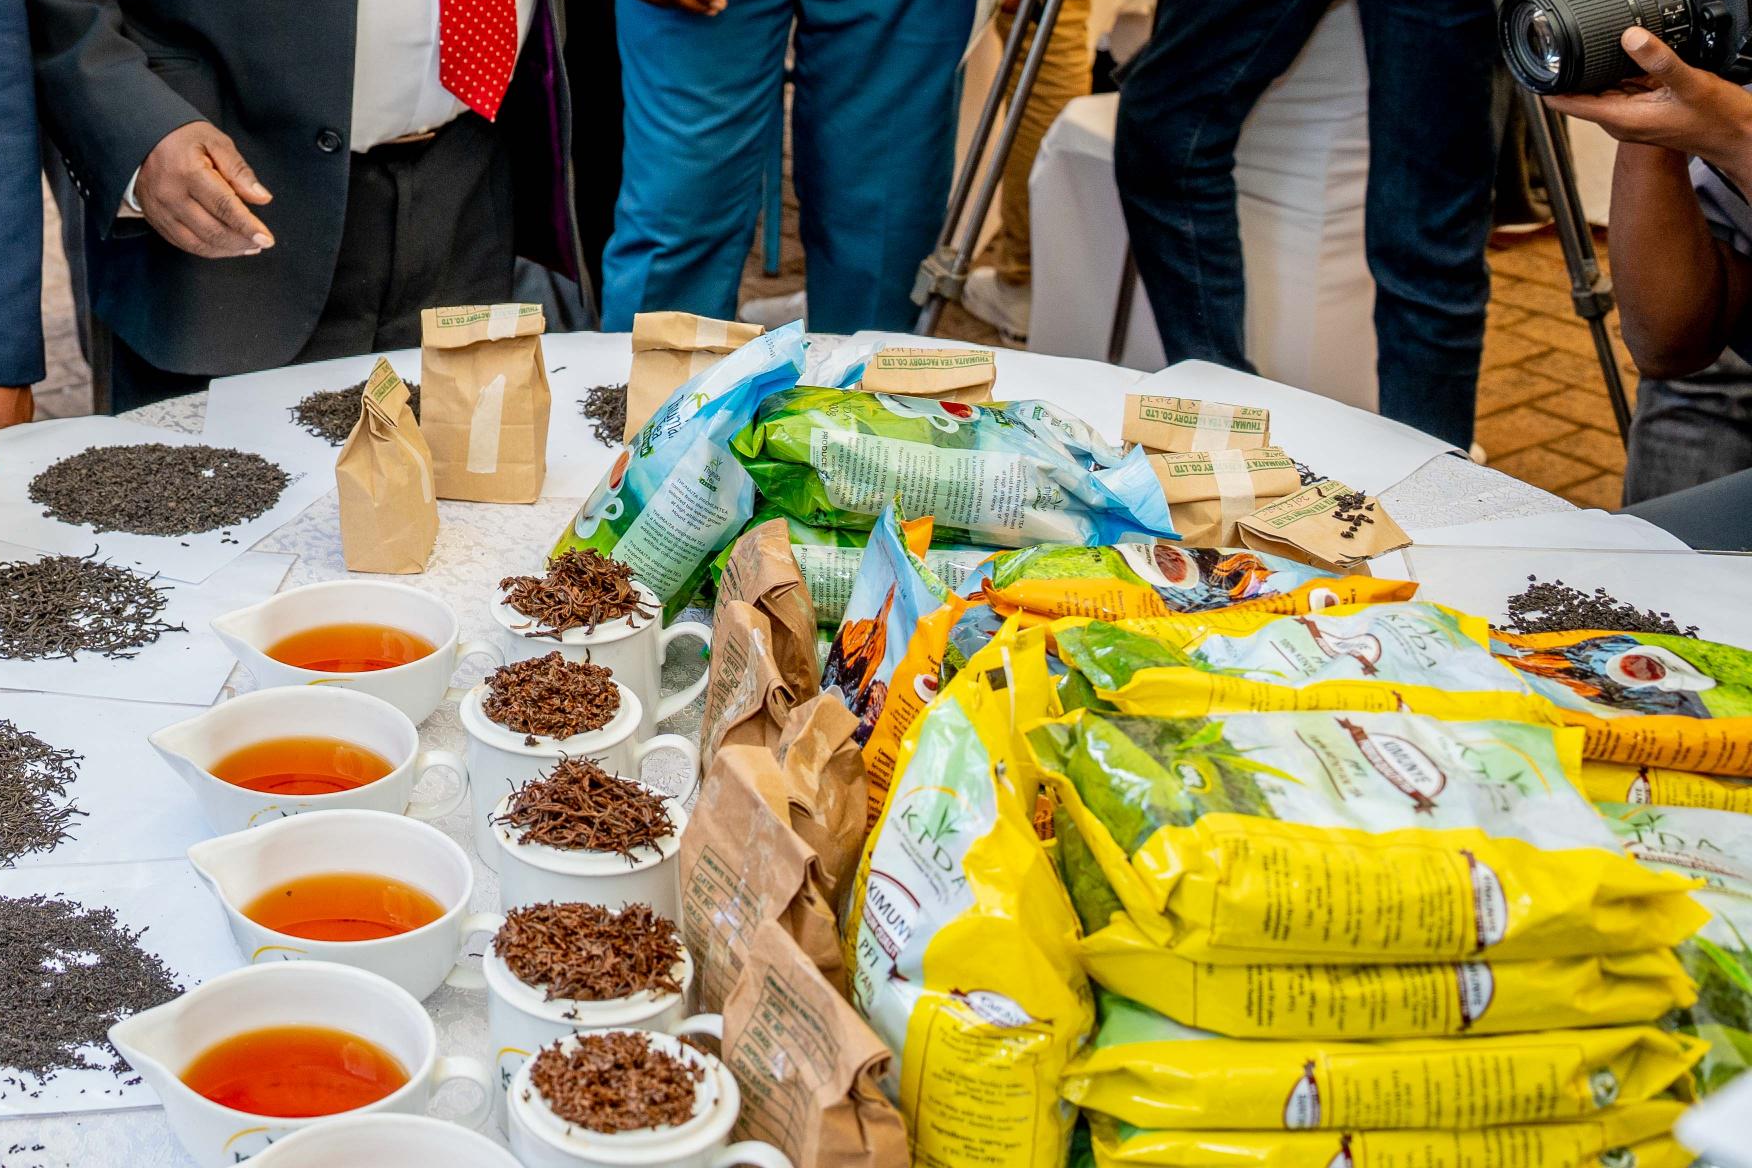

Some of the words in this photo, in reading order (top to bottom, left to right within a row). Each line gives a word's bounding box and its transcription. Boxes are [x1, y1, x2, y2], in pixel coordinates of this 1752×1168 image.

[440, 317, 453, 326] LTD
[880, 357, 895, 367] LTD
[908, 356, 939, 367] FACTORY
[939, 357, 953, 367] TEA
[953, 354, 989, 366] THUMAITA
[1143, 407, 1160, 419] LTD
[1173, 463, 1188, 473] LTD
[1252, 458, 1291, 470] THUMAITA
[675, 478, 700, 498] THUMAITA
[651, 509, 675, 529] THUMAITA
[900, 804, 969, 894] KTDA
[865, 878, 913, 945] KIMUNY
